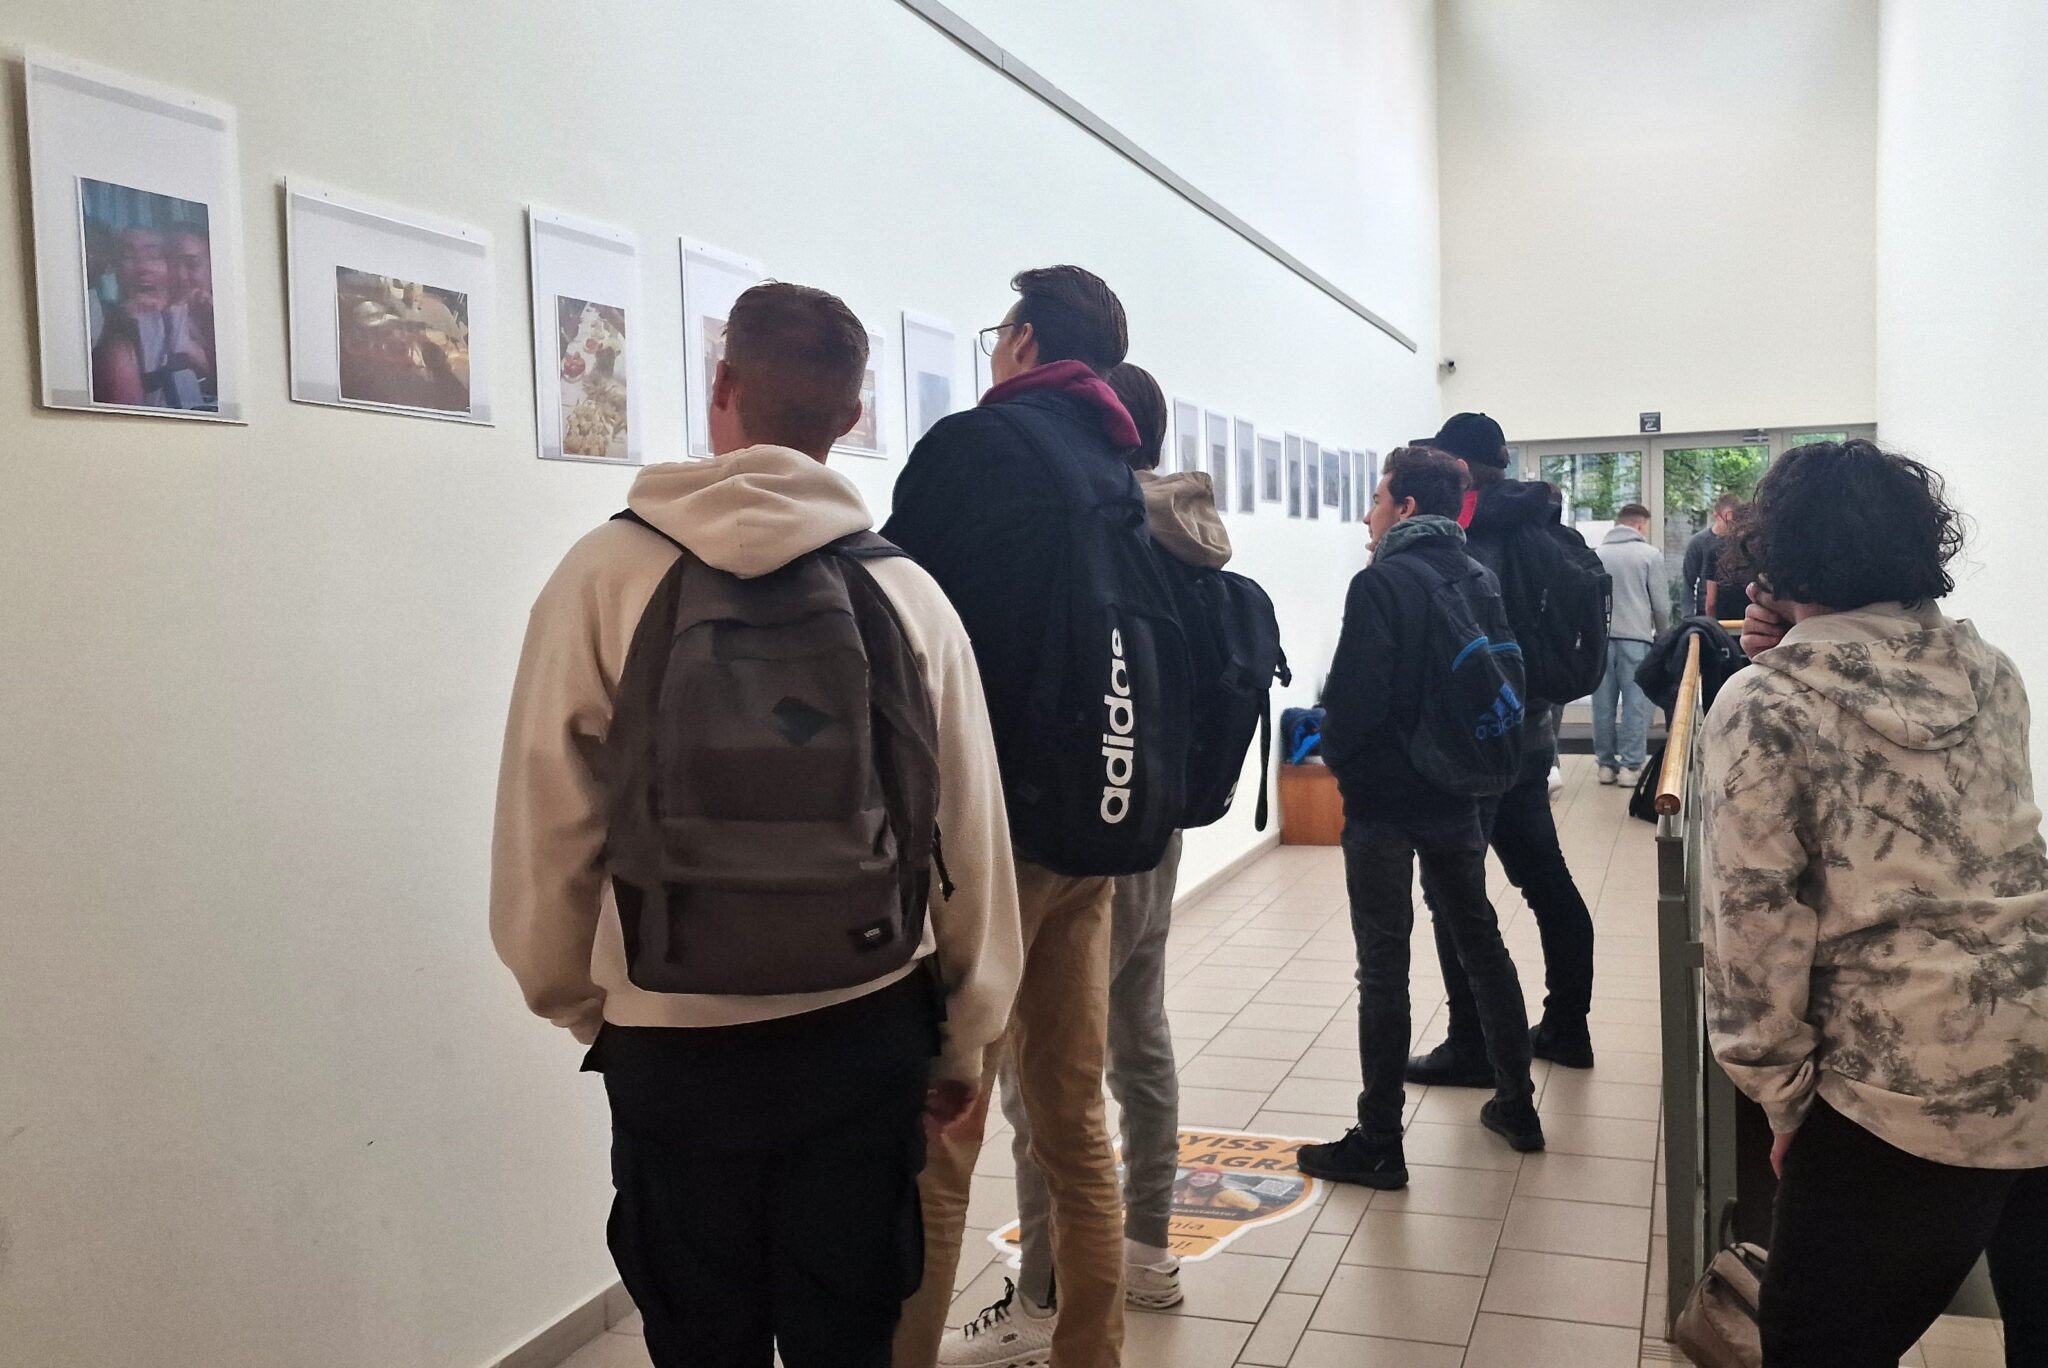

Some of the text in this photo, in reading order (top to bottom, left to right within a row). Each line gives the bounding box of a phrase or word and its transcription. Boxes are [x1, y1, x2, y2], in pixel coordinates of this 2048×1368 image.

[1475, 708, 1525, 740] adida
[1177, 1134, 1276, 1151] YISS
[1177, 1151, 1300, 1171] ÁGRA
